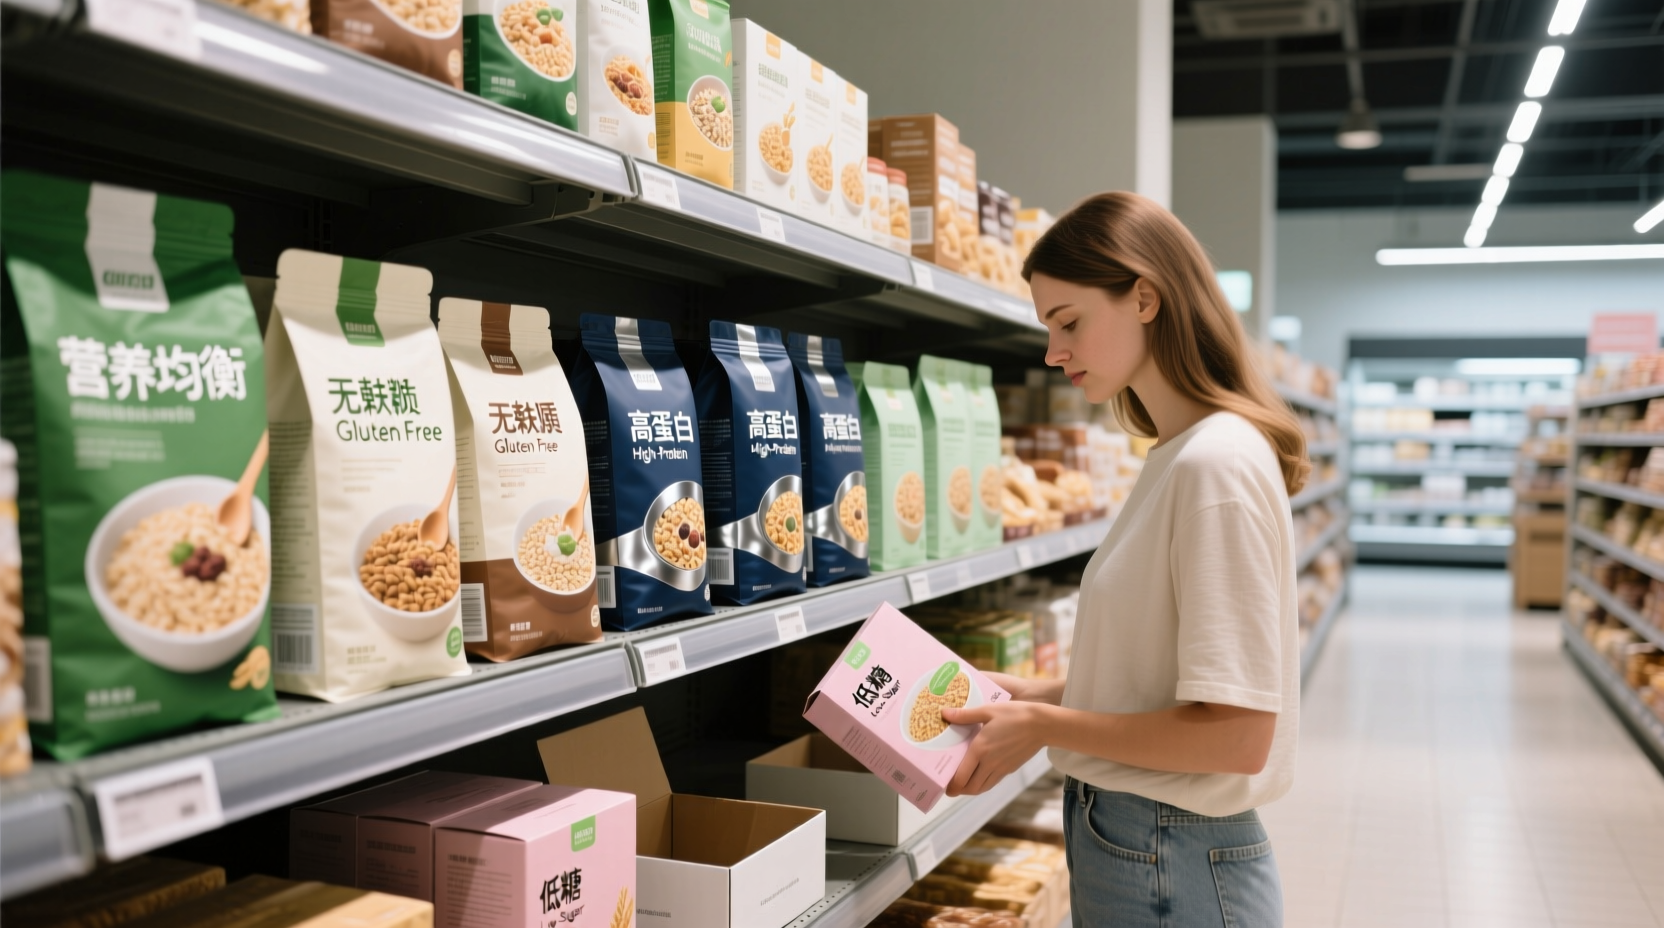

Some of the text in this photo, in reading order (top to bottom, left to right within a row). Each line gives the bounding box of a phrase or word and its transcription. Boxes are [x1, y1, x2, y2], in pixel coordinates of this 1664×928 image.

[57, 335, 246, 401] 营养均衡
[336, 420, 442, 441] Gluten Free
[627, 409, 694, 442] 高蛋白
[746, 409, 798, 439] 高蛋白
[820, 412, 862, 440] 高蛋白
[494, 438, 535, 453] Gluten
[852, 664, 893, 709] 低糖
[539, 867, 582, 914] 低糖
